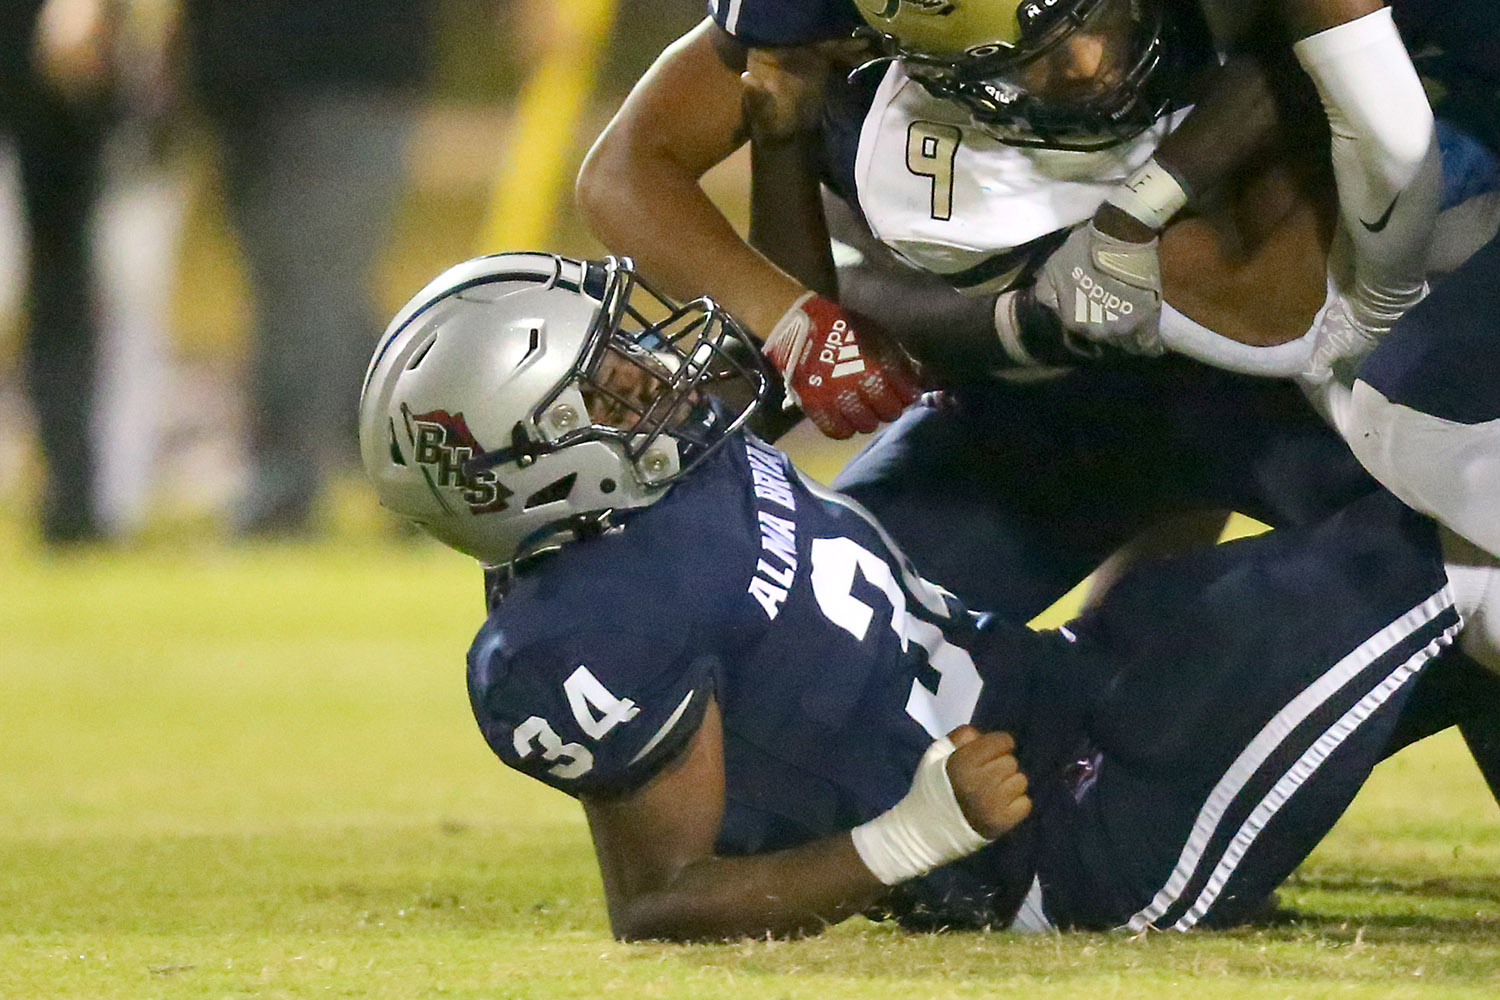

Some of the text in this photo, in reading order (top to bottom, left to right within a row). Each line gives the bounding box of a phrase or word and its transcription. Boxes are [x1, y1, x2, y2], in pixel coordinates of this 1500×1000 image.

[906, 120, 962, 221] 9
[1072, 266, 1134, 316] adidas
[808, 319, 847, 386] adids
[414, 420, 498, 507] BHS
[748, 511, 798, 621] ALMA
[513, 665, 641, 779] 34
